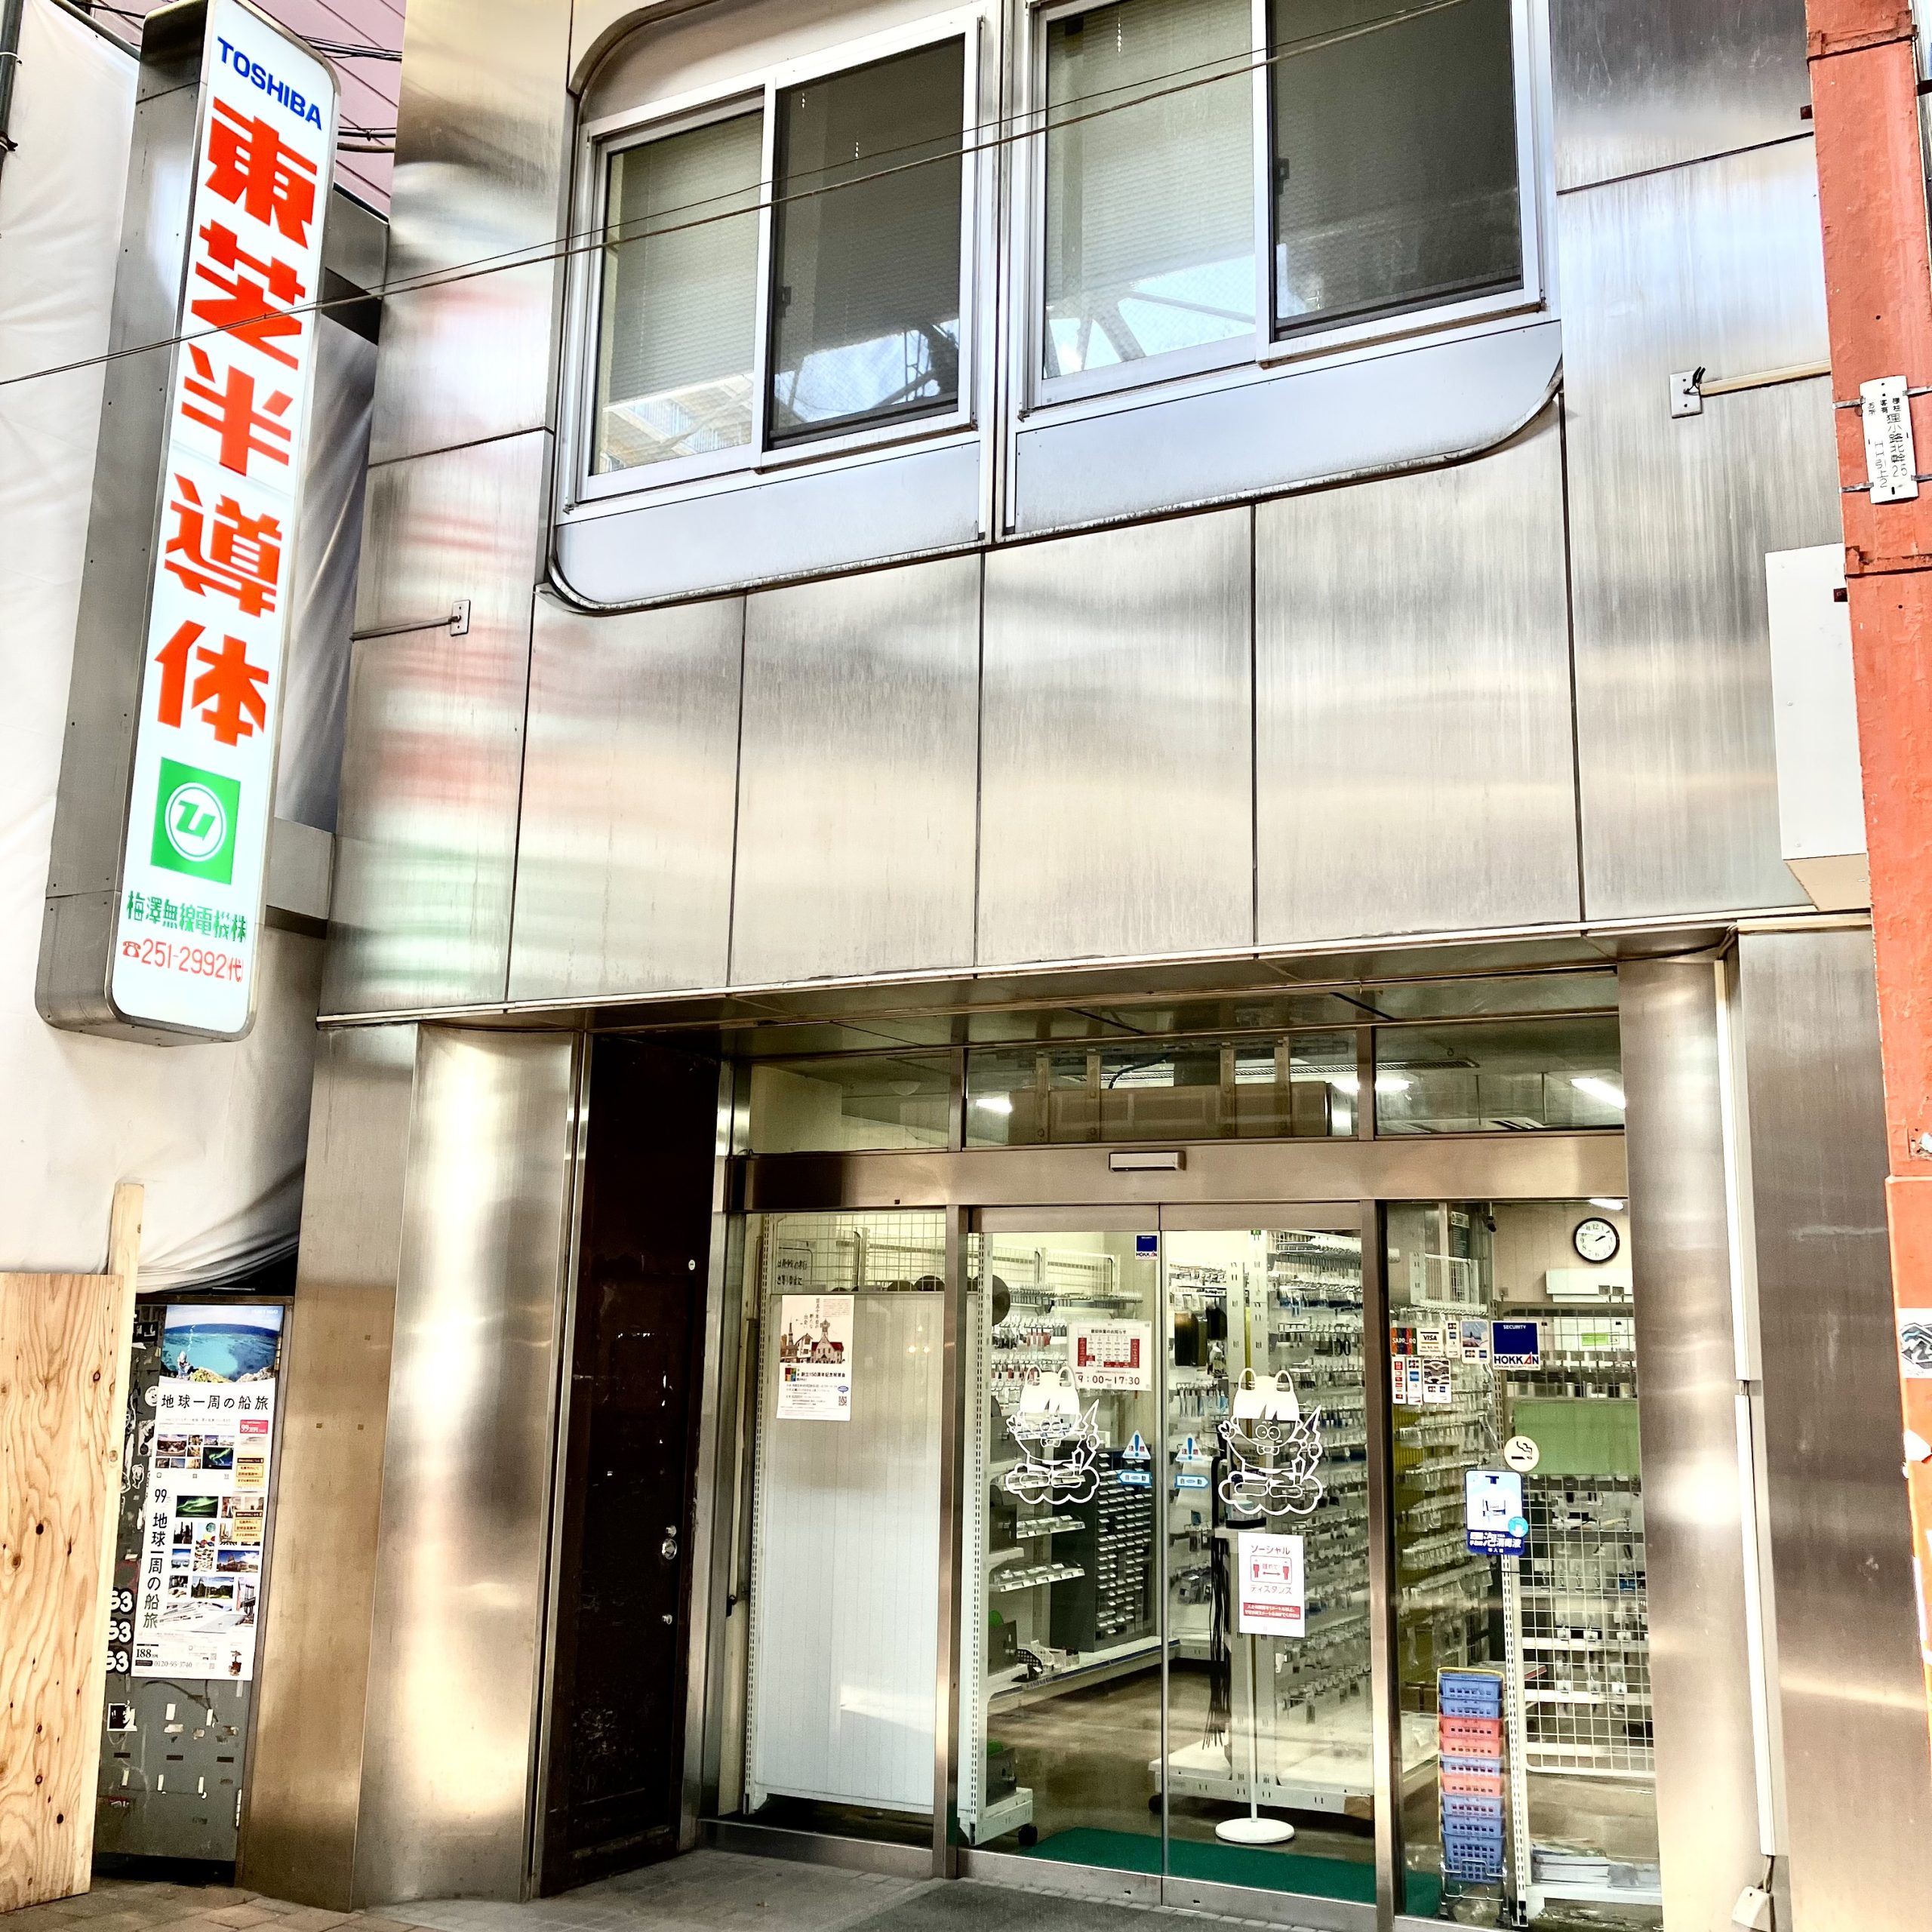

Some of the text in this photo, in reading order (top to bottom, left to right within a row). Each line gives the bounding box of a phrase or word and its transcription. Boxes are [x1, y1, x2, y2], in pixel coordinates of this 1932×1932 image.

[217, 35, 322, 131] TOSHIBA
[154, 97, 317, 746] 東芝半導体
[161, 1394, 269, 1411] 地球一周の船旅
[154, 1488, 168, 1504] 99
[1251, 1545, 1291, 1555] ソーシャル
[142, 1512, 168, 1630] 地球一周の船旅
[1251, 1584, 1292, 1595] ディスタンス
